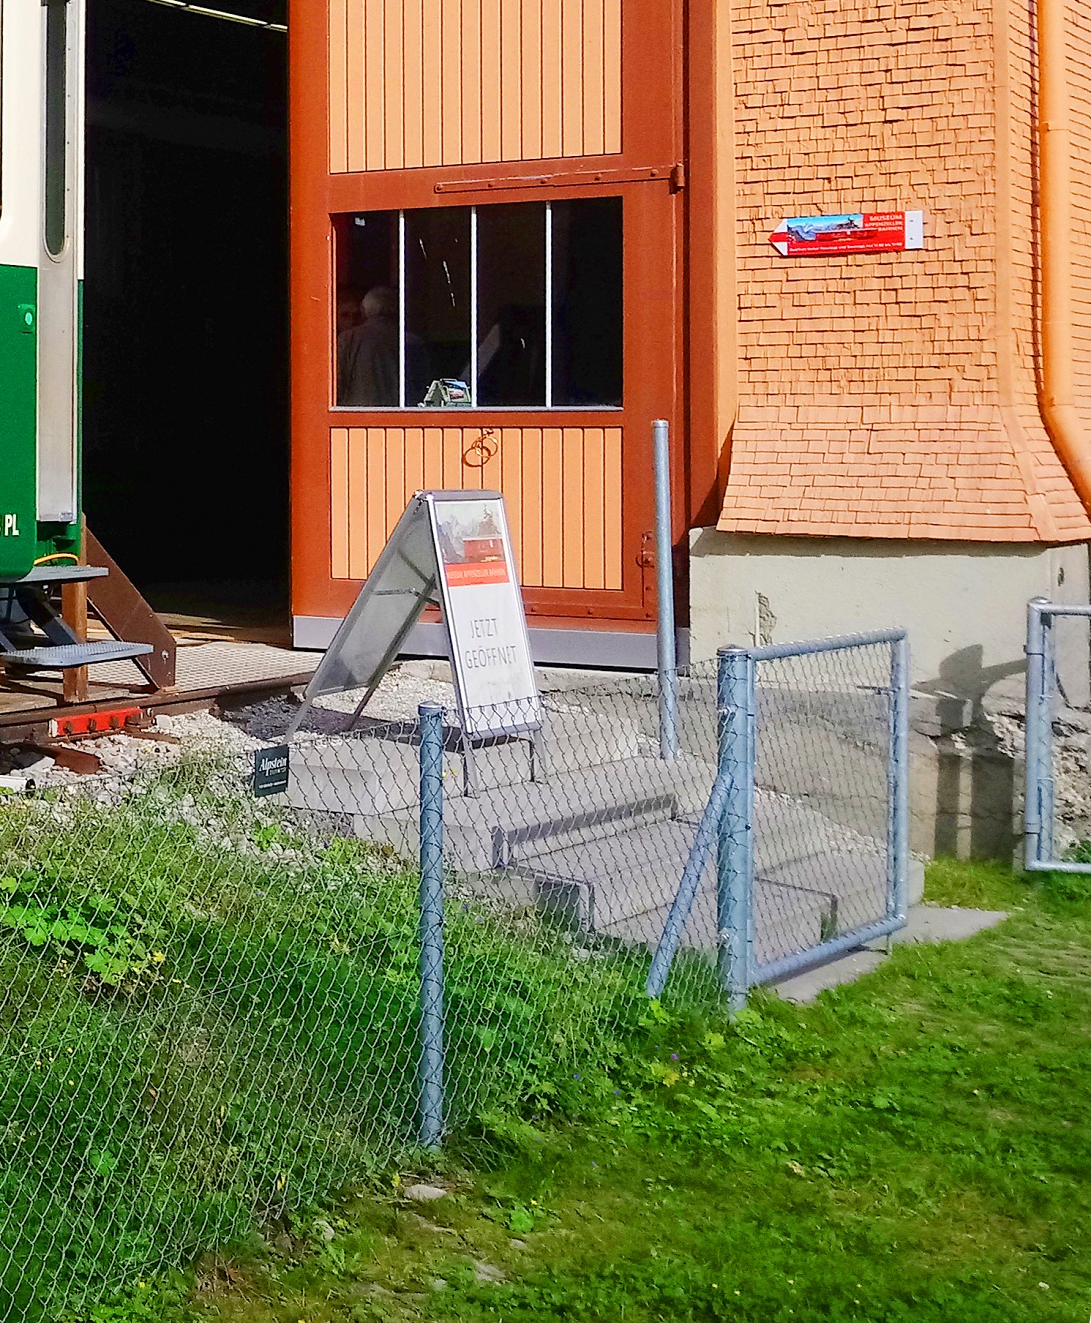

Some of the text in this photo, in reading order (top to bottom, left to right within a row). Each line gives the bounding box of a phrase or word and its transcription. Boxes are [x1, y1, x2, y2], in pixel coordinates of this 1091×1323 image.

[4, 513, 20, 536] PL
[470, 618, 498, 638] JETZT
[465, 645, 517, 669] GEÖFFNET
